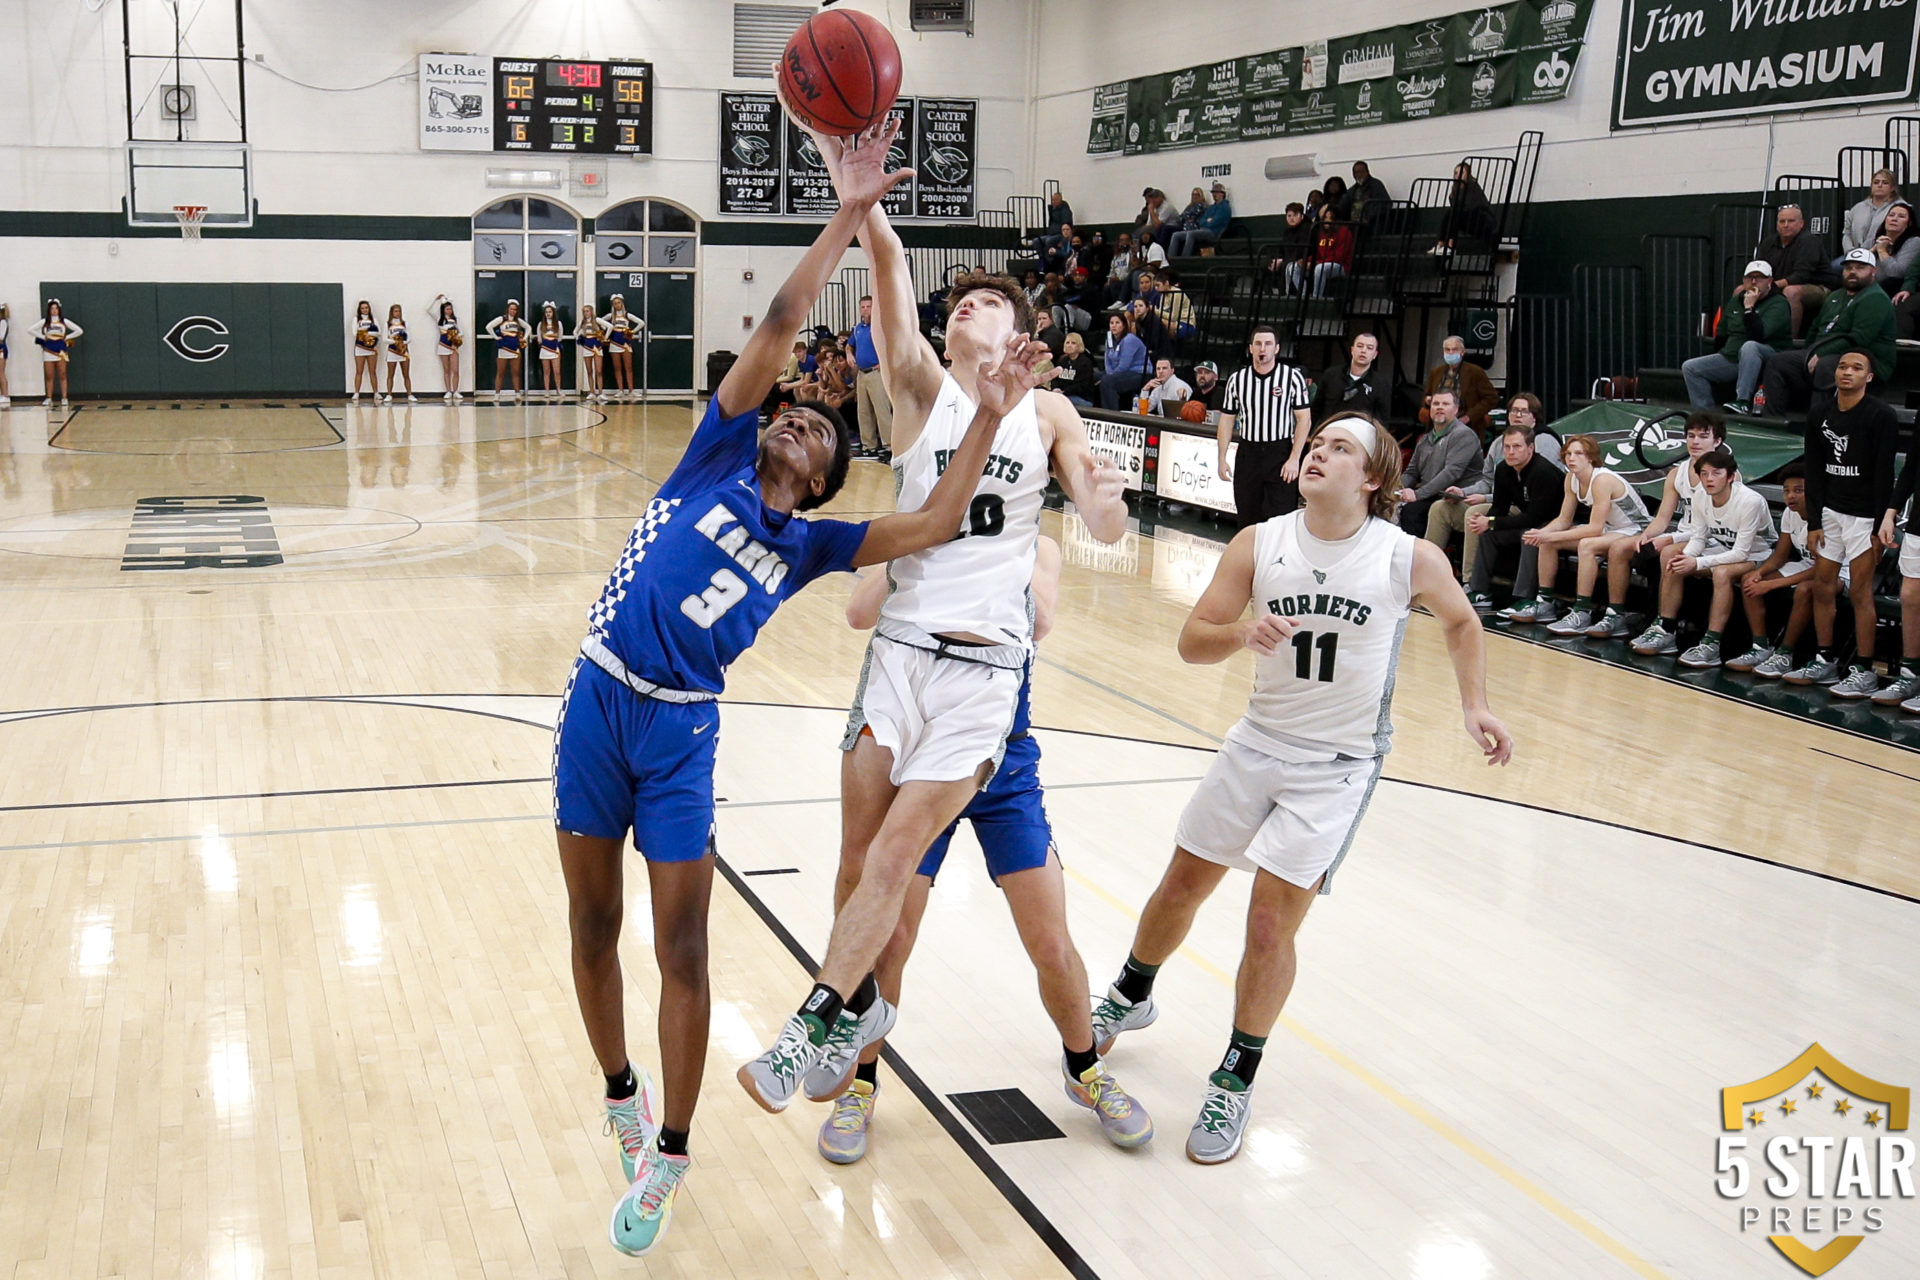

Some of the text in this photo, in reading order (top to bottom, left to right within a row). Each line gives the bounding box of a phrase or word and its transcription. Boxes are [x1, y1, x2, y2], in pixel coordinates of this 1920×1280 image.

[1632, 0, 1908, 53] Jim Willia
[1343, 42, 1394, 65] GRAHAM
[426, 63, 487, 77] McRae
[500, 62, 538, 73] GUEST
[611, 66, 645, 77] HOME
[1645, 41, 1884, 103] GYMNASIUM
[558, 64, 602, 87] 4:30
[507, 76, 534, 99] 62
[618, 80, 643, 103] 58
[545, 97, 578, 106] PERIOD
[583, 94, 593, 111] 4
[732, 103, 771, 112] CARTER
[738, 113, 764, 122] HIGH
[889, 110, 905, 119] TER
[927, 110, 968, 121] CARTER
[425, 125, 490, 134] 865-300-5715
[731, 122, 771, 132] SCHOOL
[934, 122, 961, 131] HIGH
[1242, 126, 1271, 137] Scholarship
[1271, 123, 1286, 133] Fund
[516, 124, 526, 141] 6
[564, 125, 594, 143] 3 2
[625, 127, 635, 144] 3
[926, 132, 967, 142] SCHOOL
[615, 144, 640, 152] POINTS
[722, 167, 779, 176] Boys Basketball
[788, 169, 830, 178] Boys Baske
[1201, 163, 1232, 178] VISITORS
[726, 178, 775, 186] 2014-2015
[792, 178, 833, 186] 2013-201
[737, 188, 764, 198] 27-8
[803, 187, 829, 198] 26-8
[919, 184, 972, 193] Boys Basketball
[922, 194, 968, 203] 2008-2009
[884, 204, 900, 214] -11
[928, 205, 961, 215] 21-12
[630, 275, 641, 286] 25
[1084, 421, 1144, 449] TER HORNETS
[1145, 447, 1158, 458] POSS
[1091, 446, 1127, 471] SKETBALL
[935, 449, 1024, 484] HETS
[1172, 461, 1211, 492] Drayer
[1195, 496, 1237, 512] WWW.DRAYERPT.C
[694, 502, 789, 595] KARNS
[680, 567, 749, 629] 3
[1267, 594, 1372, 626] HORNETS
[1291, 631, 1339, 682] 11
